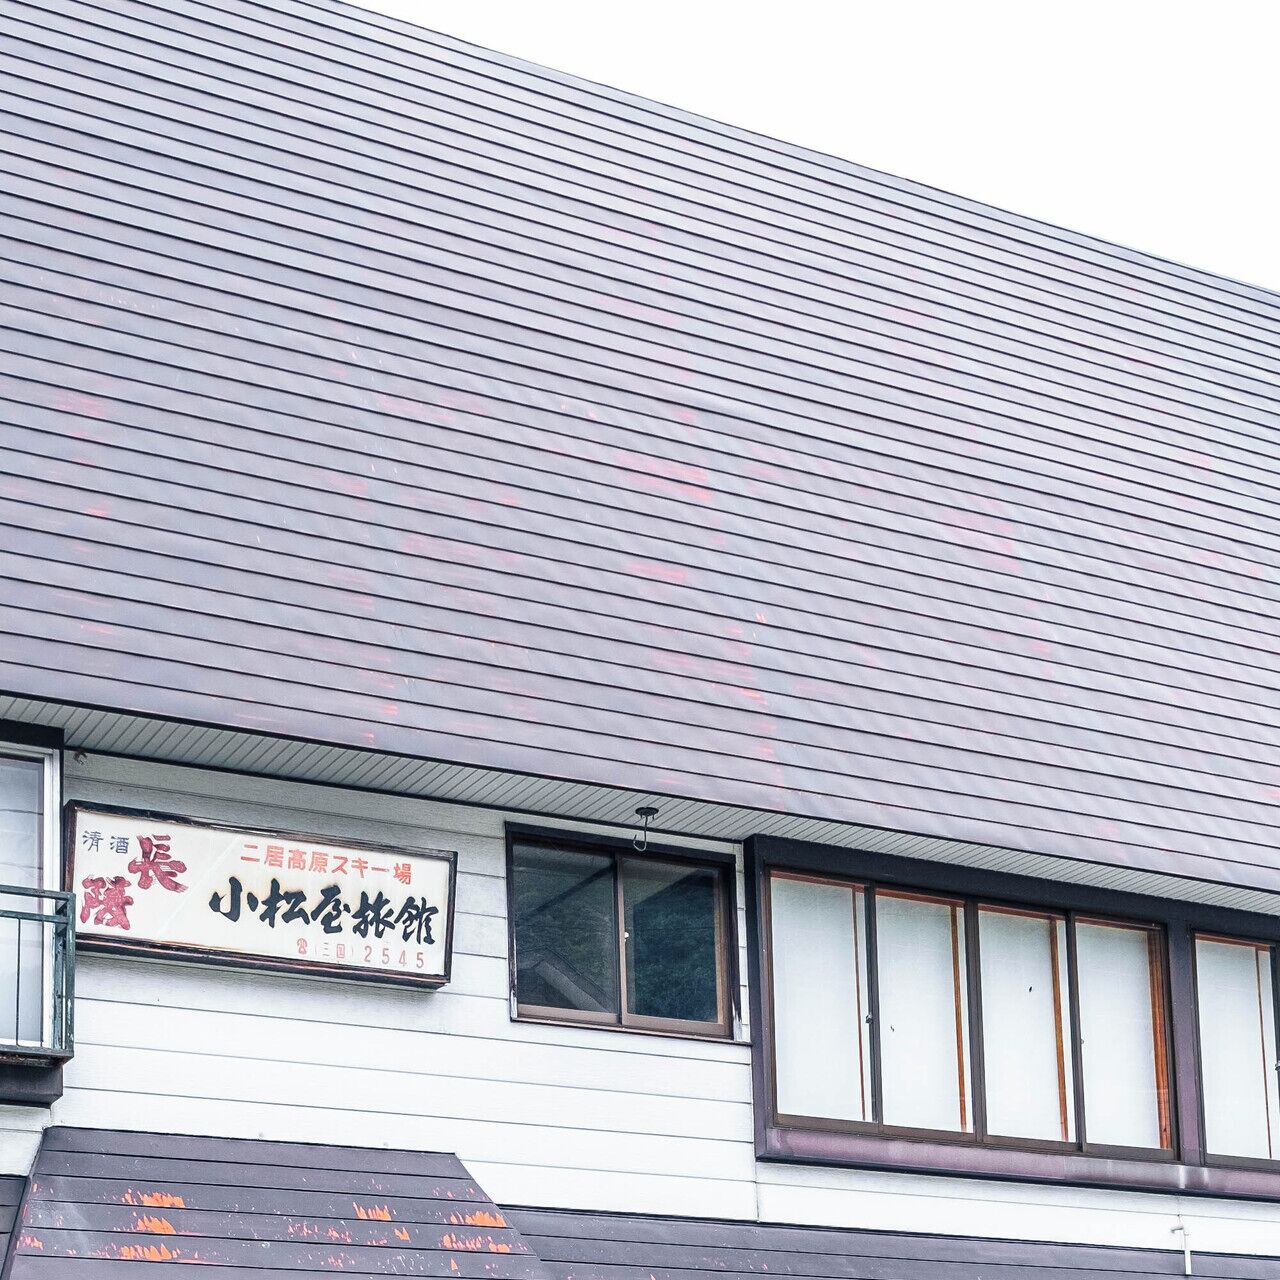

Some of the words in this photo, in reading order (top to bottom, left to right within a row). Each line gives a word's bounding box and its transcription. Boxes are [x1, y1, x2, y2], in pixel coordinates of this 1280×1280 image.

[82, 830, 130, 855] 清酒
[239, 843, 413, 886] 二居高原スキー場
[208, 876, 440, 945] 小松屋旅館
